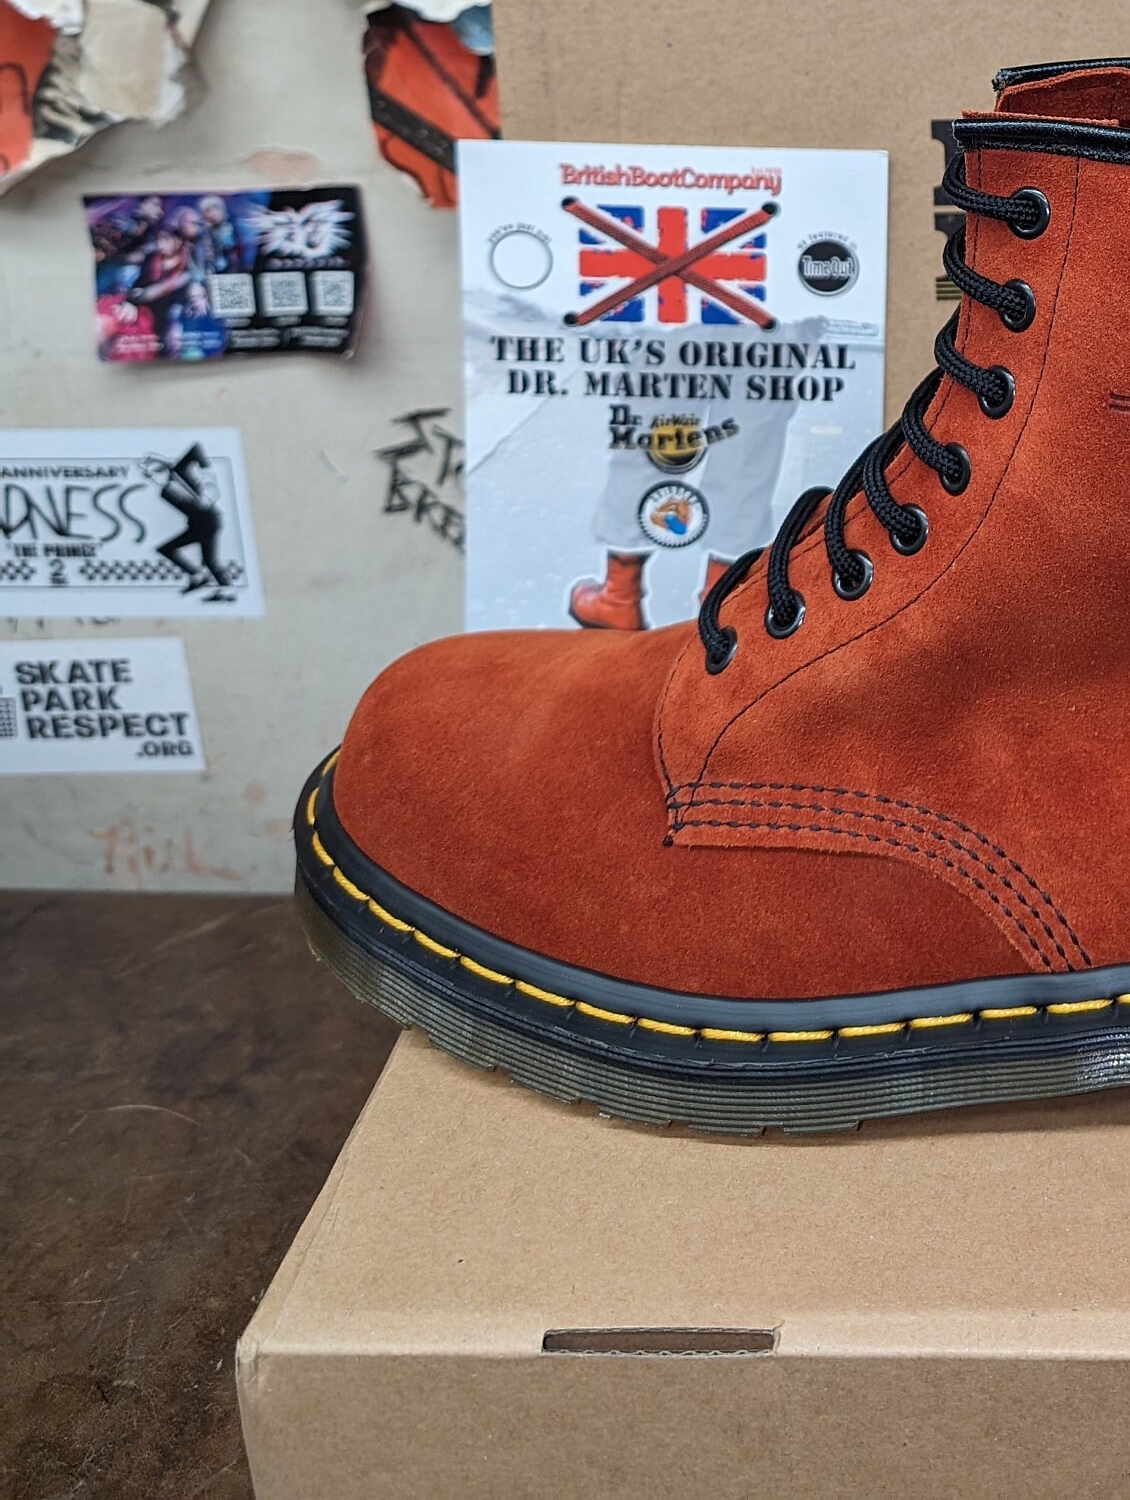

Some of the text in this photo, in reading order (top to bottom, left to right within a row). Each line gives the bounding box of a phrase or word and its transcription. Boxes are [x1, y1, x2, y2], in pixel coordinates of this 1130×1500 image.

[560, 163, 782, 196] BritishBootCompany
[491, 336, 856, 370] THE UK'S ORIGINAL
[508, 369, 845, 401] DR. MARTEN SHOP
[609, 417, 740, 450] Martens
[15, 658, 132, 685] SKATE
[20, 685, 122, 712] PARK
[26, 711, 189, 739] RESPECT
[136, 740, 195, 757] .ORG
